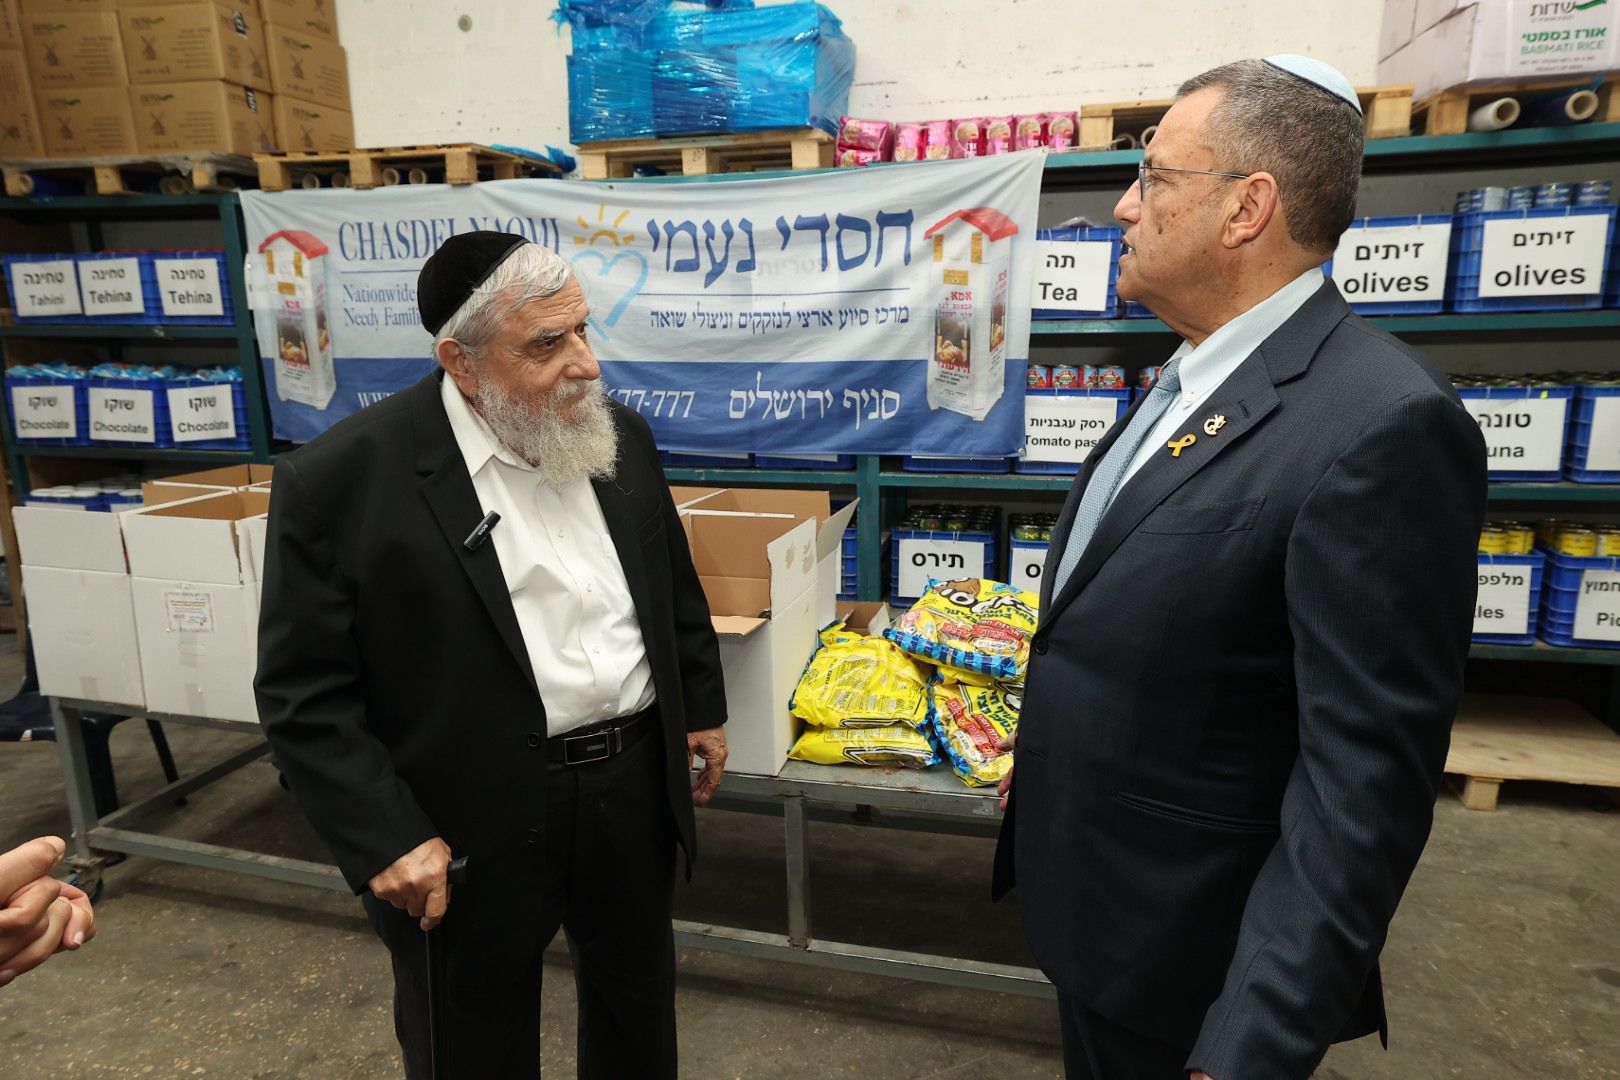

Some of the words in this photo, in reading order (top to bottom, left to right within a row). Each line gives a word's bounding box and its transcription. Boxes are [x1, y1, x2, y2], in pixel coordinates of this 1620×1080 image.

[1522, 30, 1570, 42] בסמטי
[1575, 27, 1607, 39] אורז
[1577, 40, 1603, 50] RICE
[776, 208, 912, 272] חסדי
[1513, 230, 1576, 248] זיתים
[646, 217, 756, 289] נעמי
[1355, 242, 1425, 262] זיתים
[1046, 254, 1076, 269] תה
[170, 268, 206, 281] טחינה
[1494, 265, 1587, 288] olives
[1343, 272, 1430, 294] olives
[89, 290, 133, 304] Tehina
[169, 290, 213, 304] Tehina
[342, 283, 416, 303] Nationwide
[1039, 282, 1078, 301] Tea
[344, 307, 379, 331] Needy
[650, 310, 687, 328] שואה
[692, 302, 733, 329] וניצולי
[738, 302, 791, 335] לנזקקים
[797, 310, 833, 328] ארצי
[839, 307, 869, 331] סיוע
[877, 305, 909, 324] מרכז
[728, 370, 834, 420] ירושלים
[104, 398, 135, 412] שוקו
[189, 396, 217, 411] שוקו
[608, 388, 695, 418] 77-777
[843, 389, 900, 430] סניף
[19, 420, 70, 430] Chocolate
[94, 422, 148, 434] Chocolate
[177, 420, 230, 433] Chocolate
[1030, 418, 1076, 428] עגבניות
[1080, 420, 1105, 431] רסק
[1479, 413, 1532, 428] טונה
[1026, 435, 1071, 447] Tomato
[1487, 446, 1525, 458] una
[912, 553, 964, 568] תירס
[1474, 605, 1505, 619] les
